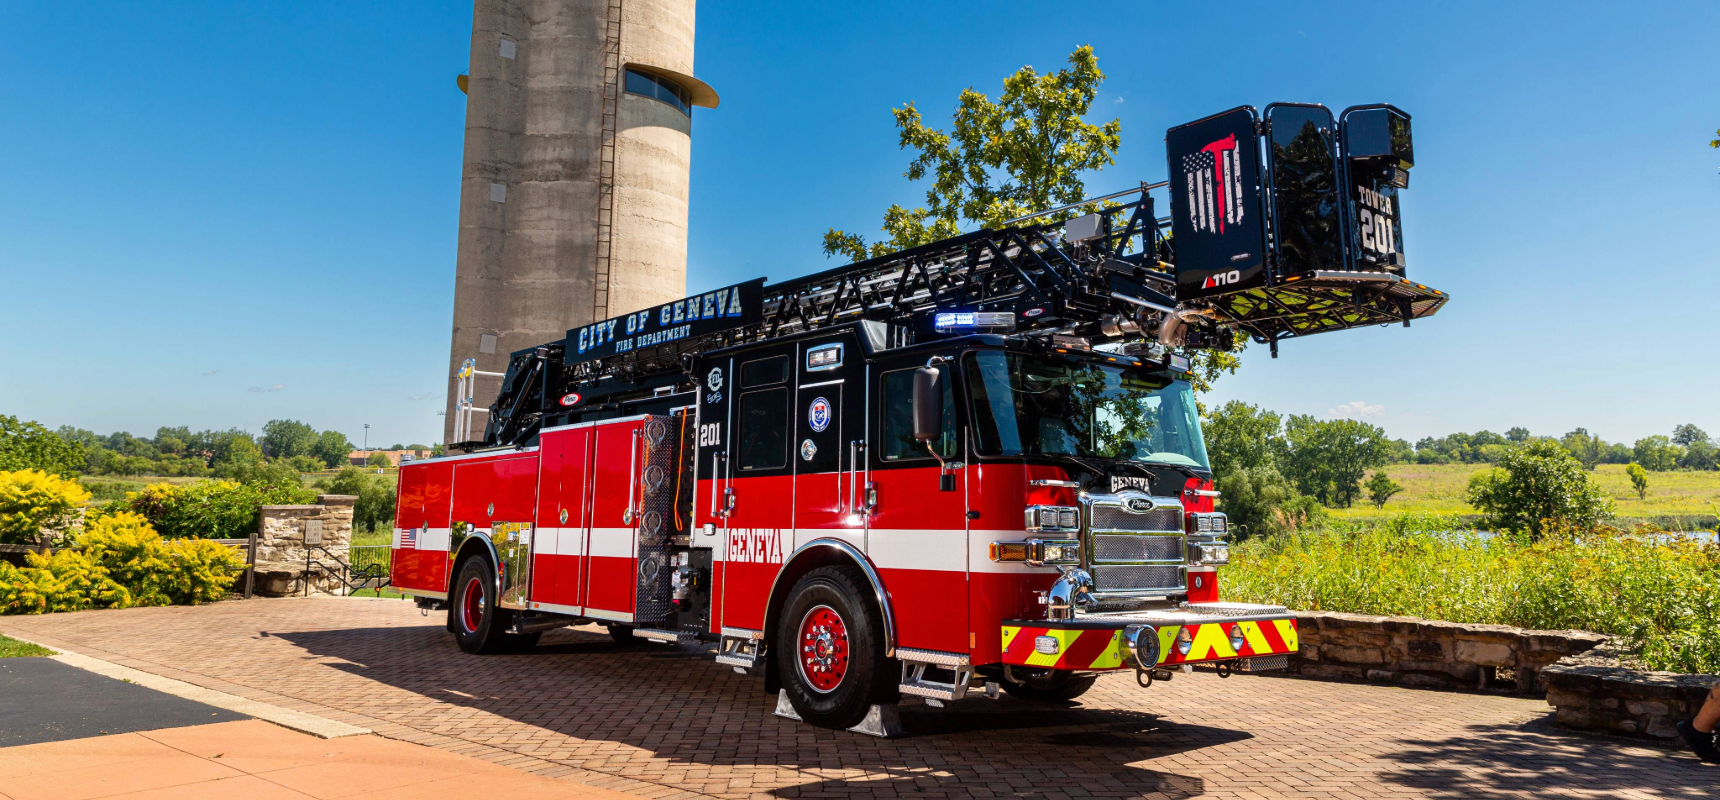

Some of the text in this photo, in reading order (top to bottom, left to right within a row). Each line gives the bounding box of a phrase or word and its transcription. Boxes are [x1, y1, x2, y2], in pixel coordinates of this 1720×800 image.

[1358, 185, 1392, 216] TOWER
[1360, 208, 1396, 254] 201
[577, 286, 742, 354] CITY OF GENEVA
[615, 324, 691, 353] FIRE DEPARTMENT
[700, 422, 720, 447] 201
[1111, 475, 1151, 496] GENEVA
[1131, 499, 1151, 509] Pierce
[729, 528, 783, 564] GENEVA
